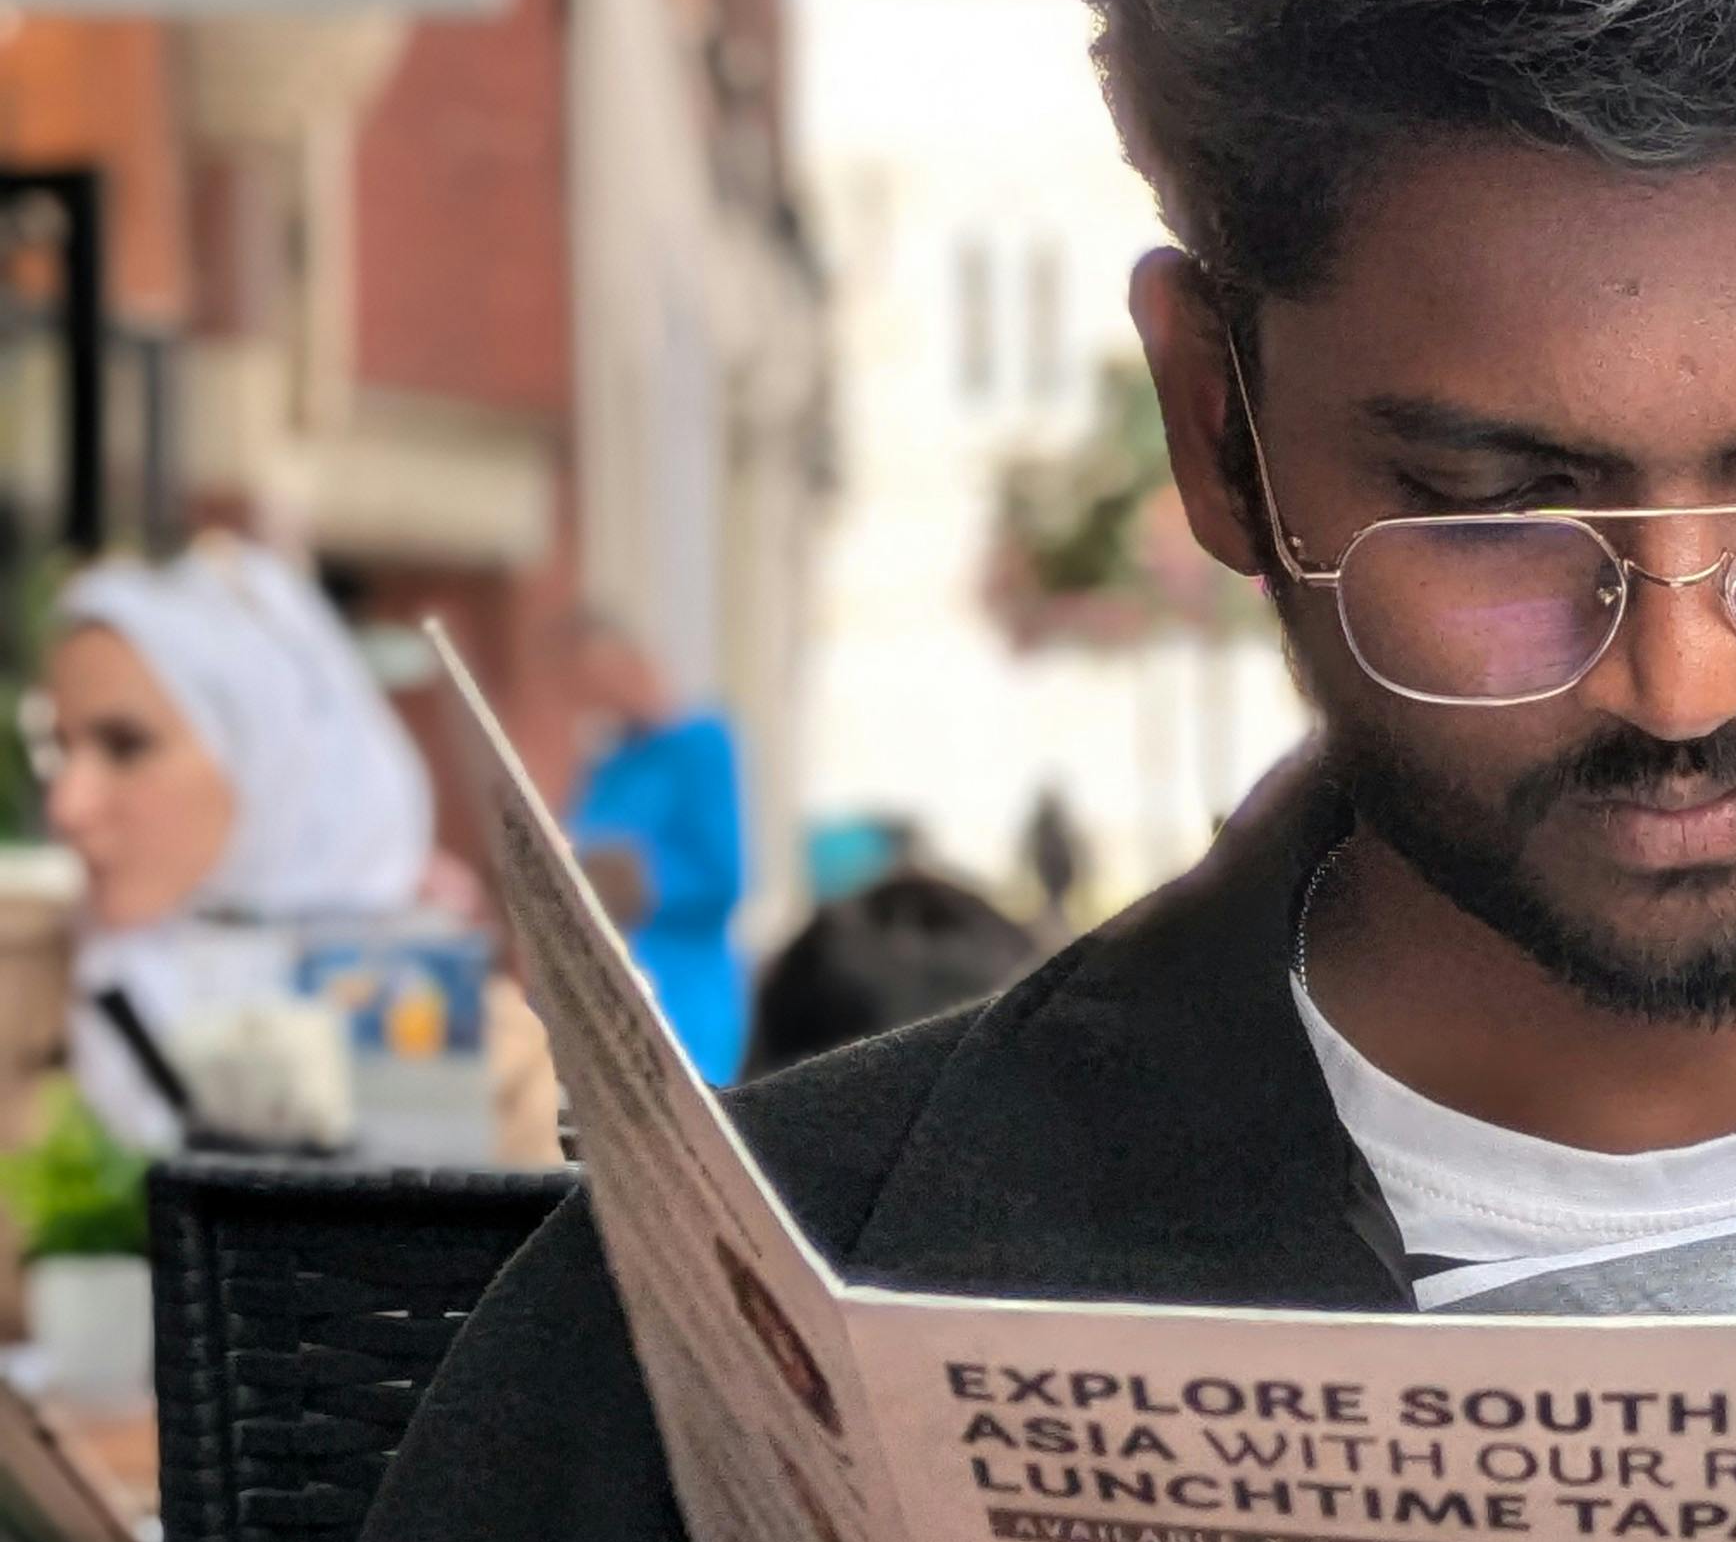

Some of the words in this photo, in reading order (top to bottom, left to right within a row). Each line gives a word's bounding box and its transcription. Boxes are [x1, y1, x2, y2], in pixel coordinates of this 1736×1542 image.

[945, 1361, 1369, 1424] EXPLORE
[1400, 1385, 1728, 1436] SOUTH
[962, 1412, 1177, 1462] ASIA
[1202, 1428, 1443, 1478] WITH
[1477, 1441, 1674, 1489] OUR
[972, 1456, 1531, 1533] LUNCHTIME
